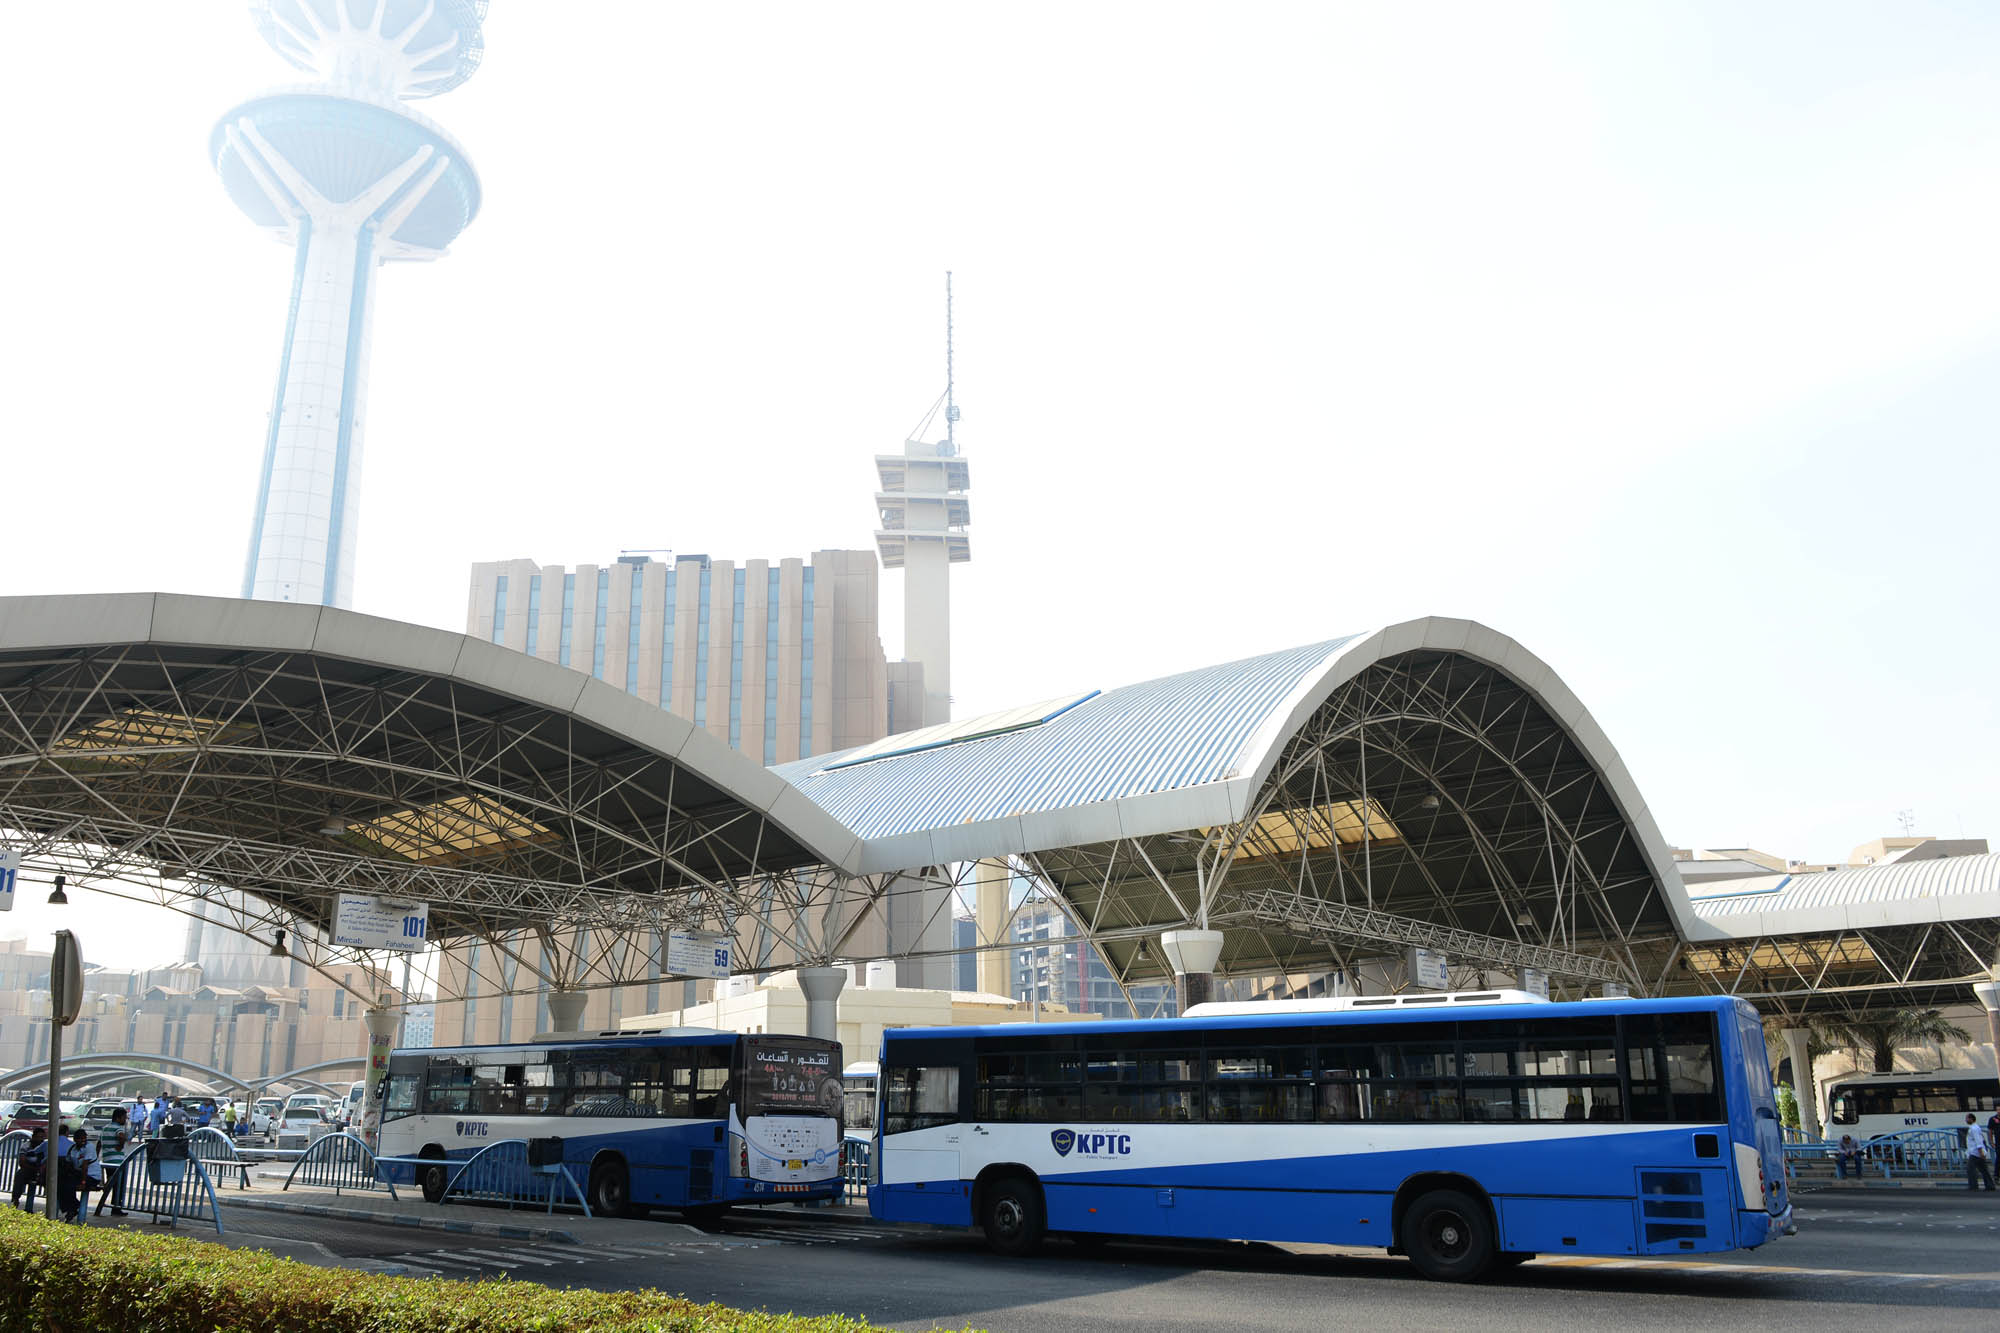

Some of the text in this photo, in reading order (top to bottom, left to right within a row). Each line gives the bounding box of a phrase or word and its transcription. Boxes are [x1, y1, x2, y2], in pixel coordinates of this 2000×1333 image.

[402, 916, 425, 938] 101
[336, 935, 363, 945] Mircab
[714, 948, 729, 967] 59
[464, 1121, 489, 1137] KPTC
[1904, 1117, 1929, 1126] KPTC
[1077, 1134, 1131, 1155] KPTC
